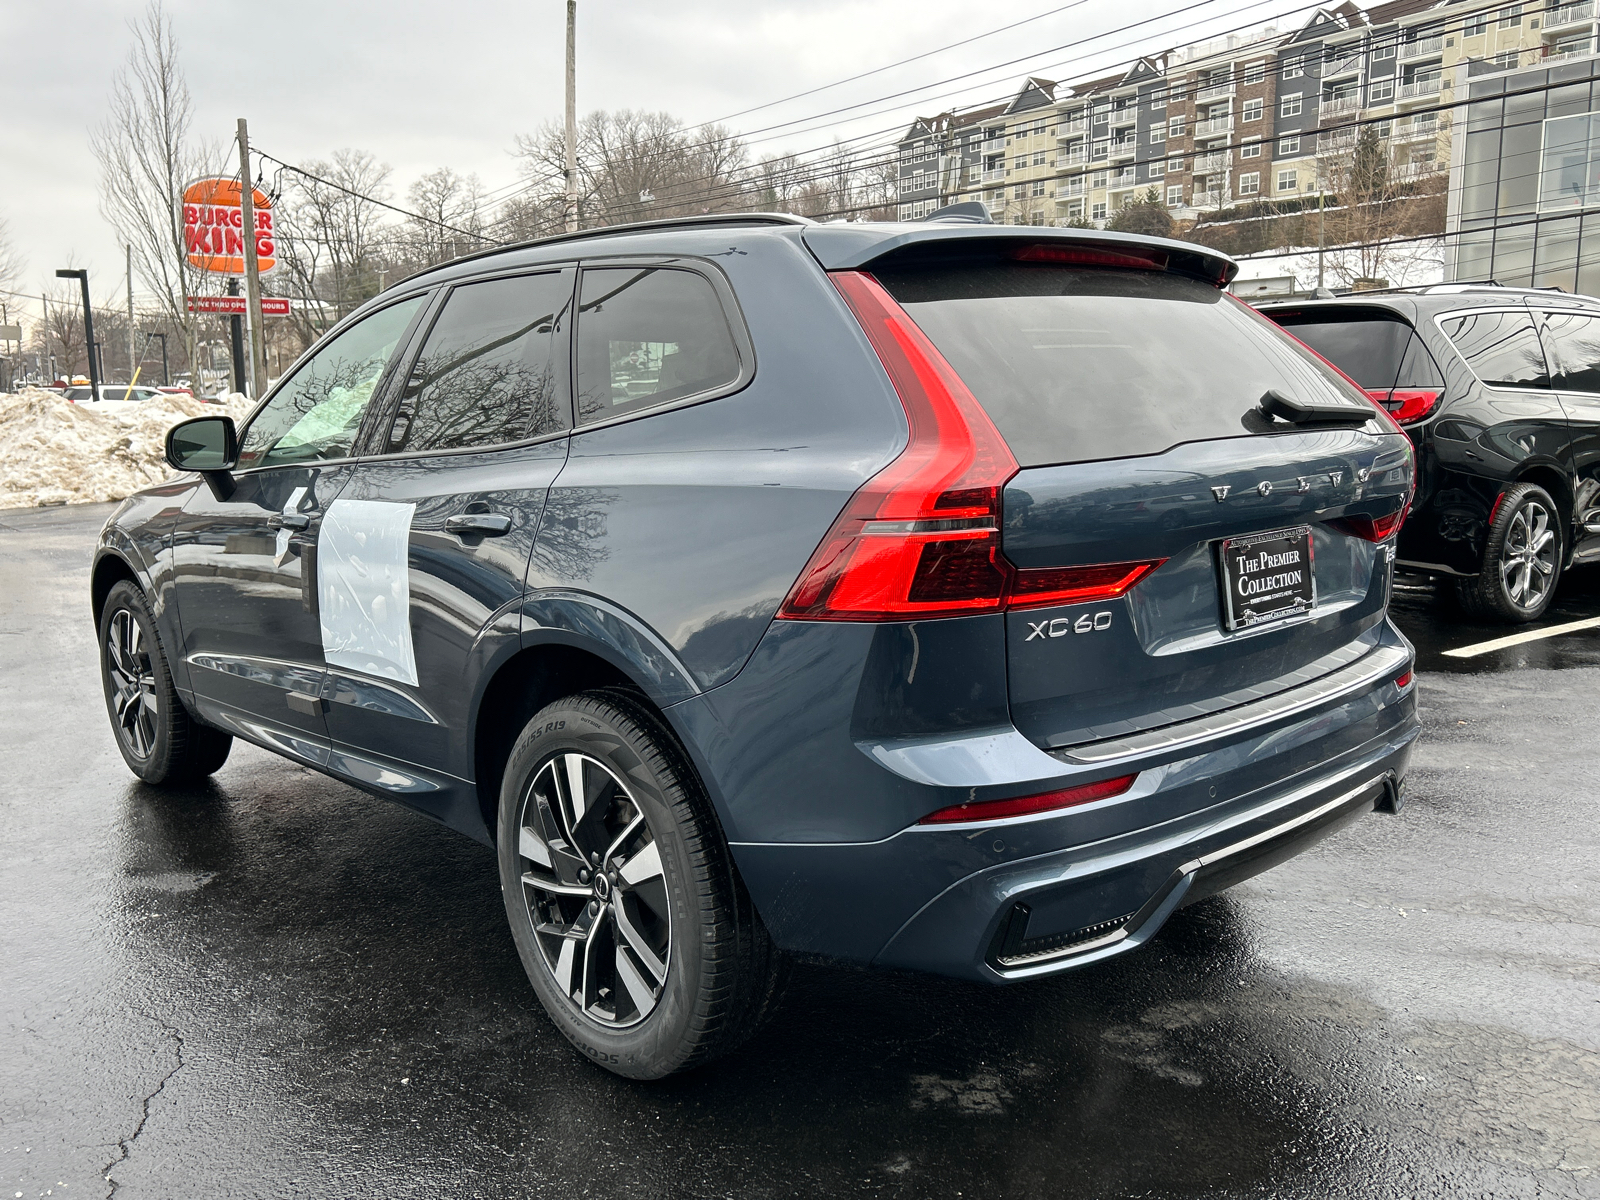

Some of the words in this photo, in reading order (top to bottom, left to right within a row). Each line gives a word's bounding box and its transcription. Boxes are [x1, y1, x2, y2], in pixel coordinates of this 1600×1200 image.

[1211, 468, 1369, 503] VOLVO
[1236, 555, 1259, 575] THE
[1259, 550, 1300, 570] PREMIER
[1238, 570, 1302, 597] COLLECTION
[1025, 611, 1112, 642] XC60
[544, 720, 566, 734] R19
[580, 716, 603, 730] OUTSIDE
